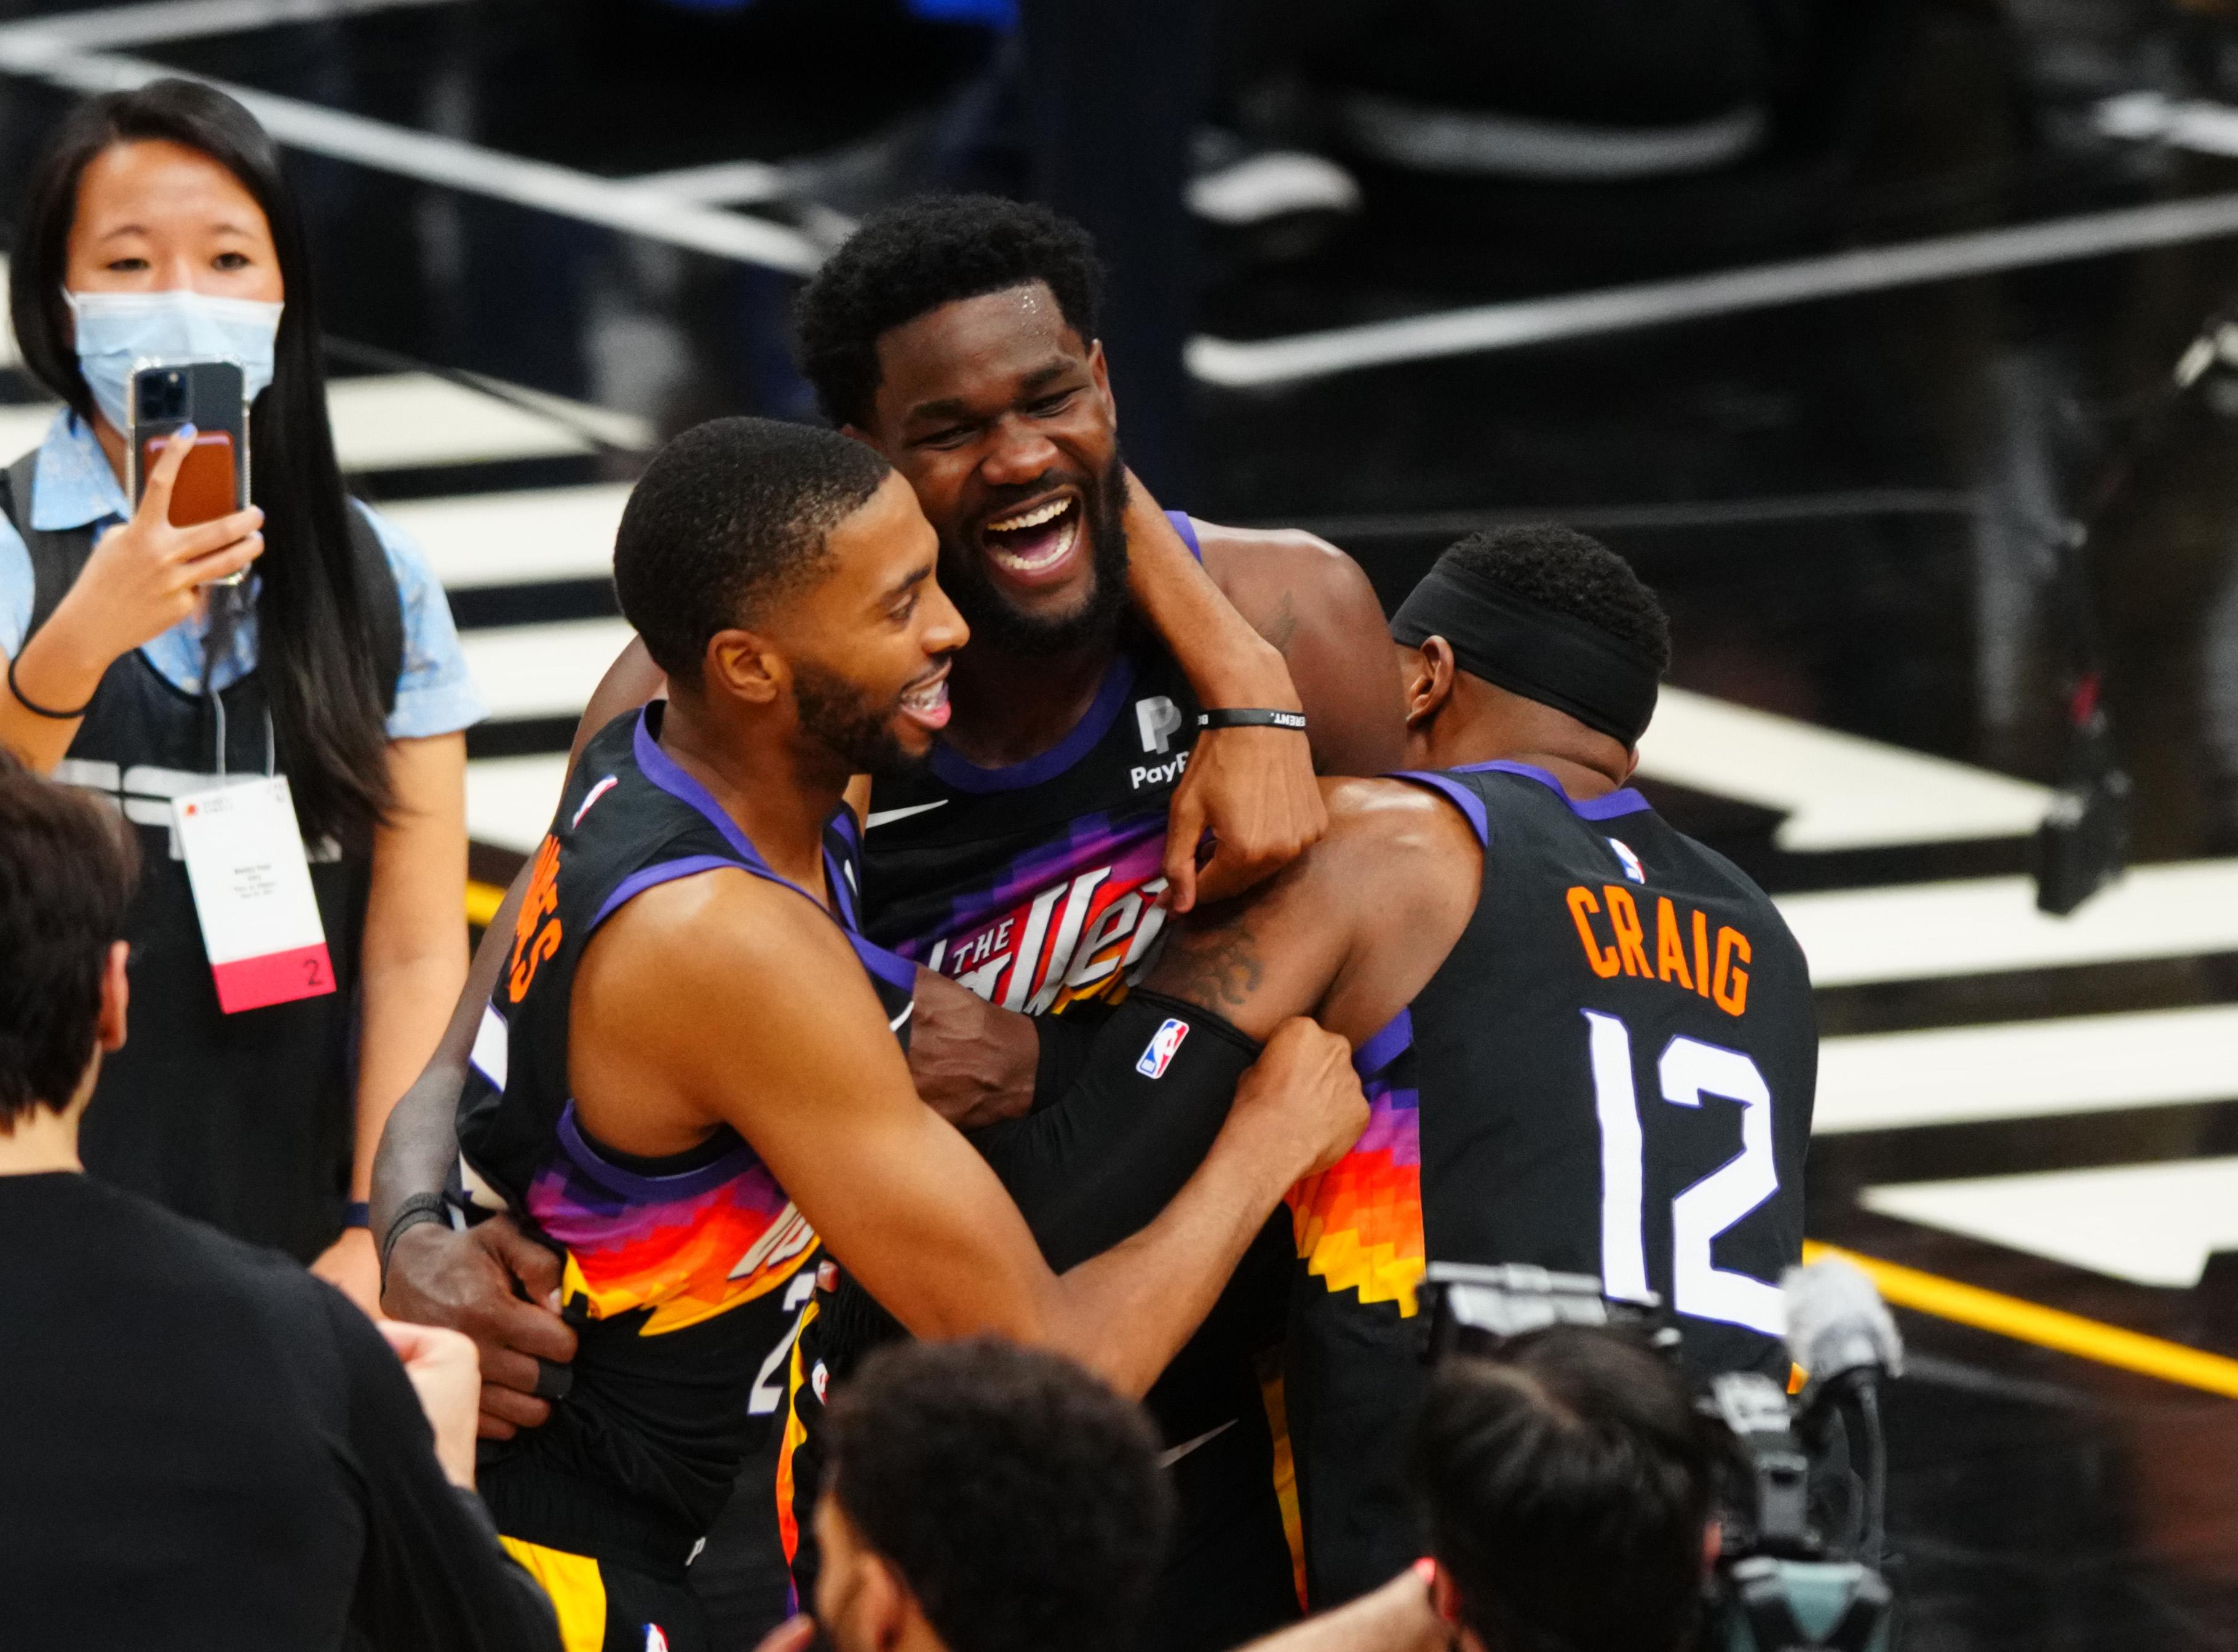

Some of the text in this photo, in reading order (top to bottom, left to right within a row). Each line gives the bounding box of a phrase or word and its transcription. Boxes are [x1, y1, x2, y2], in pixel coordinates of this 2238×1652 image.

[1271, 712, 1306, 727] ERENT.
[1130, 750, 1189, 789] PayP
[953, 918, 1014, 974] THE
[1566, 886, 1752, 1016] CRAIG
[303, 958, 324, 987] 2
[1579, 1007, 1786, 1337] 12
